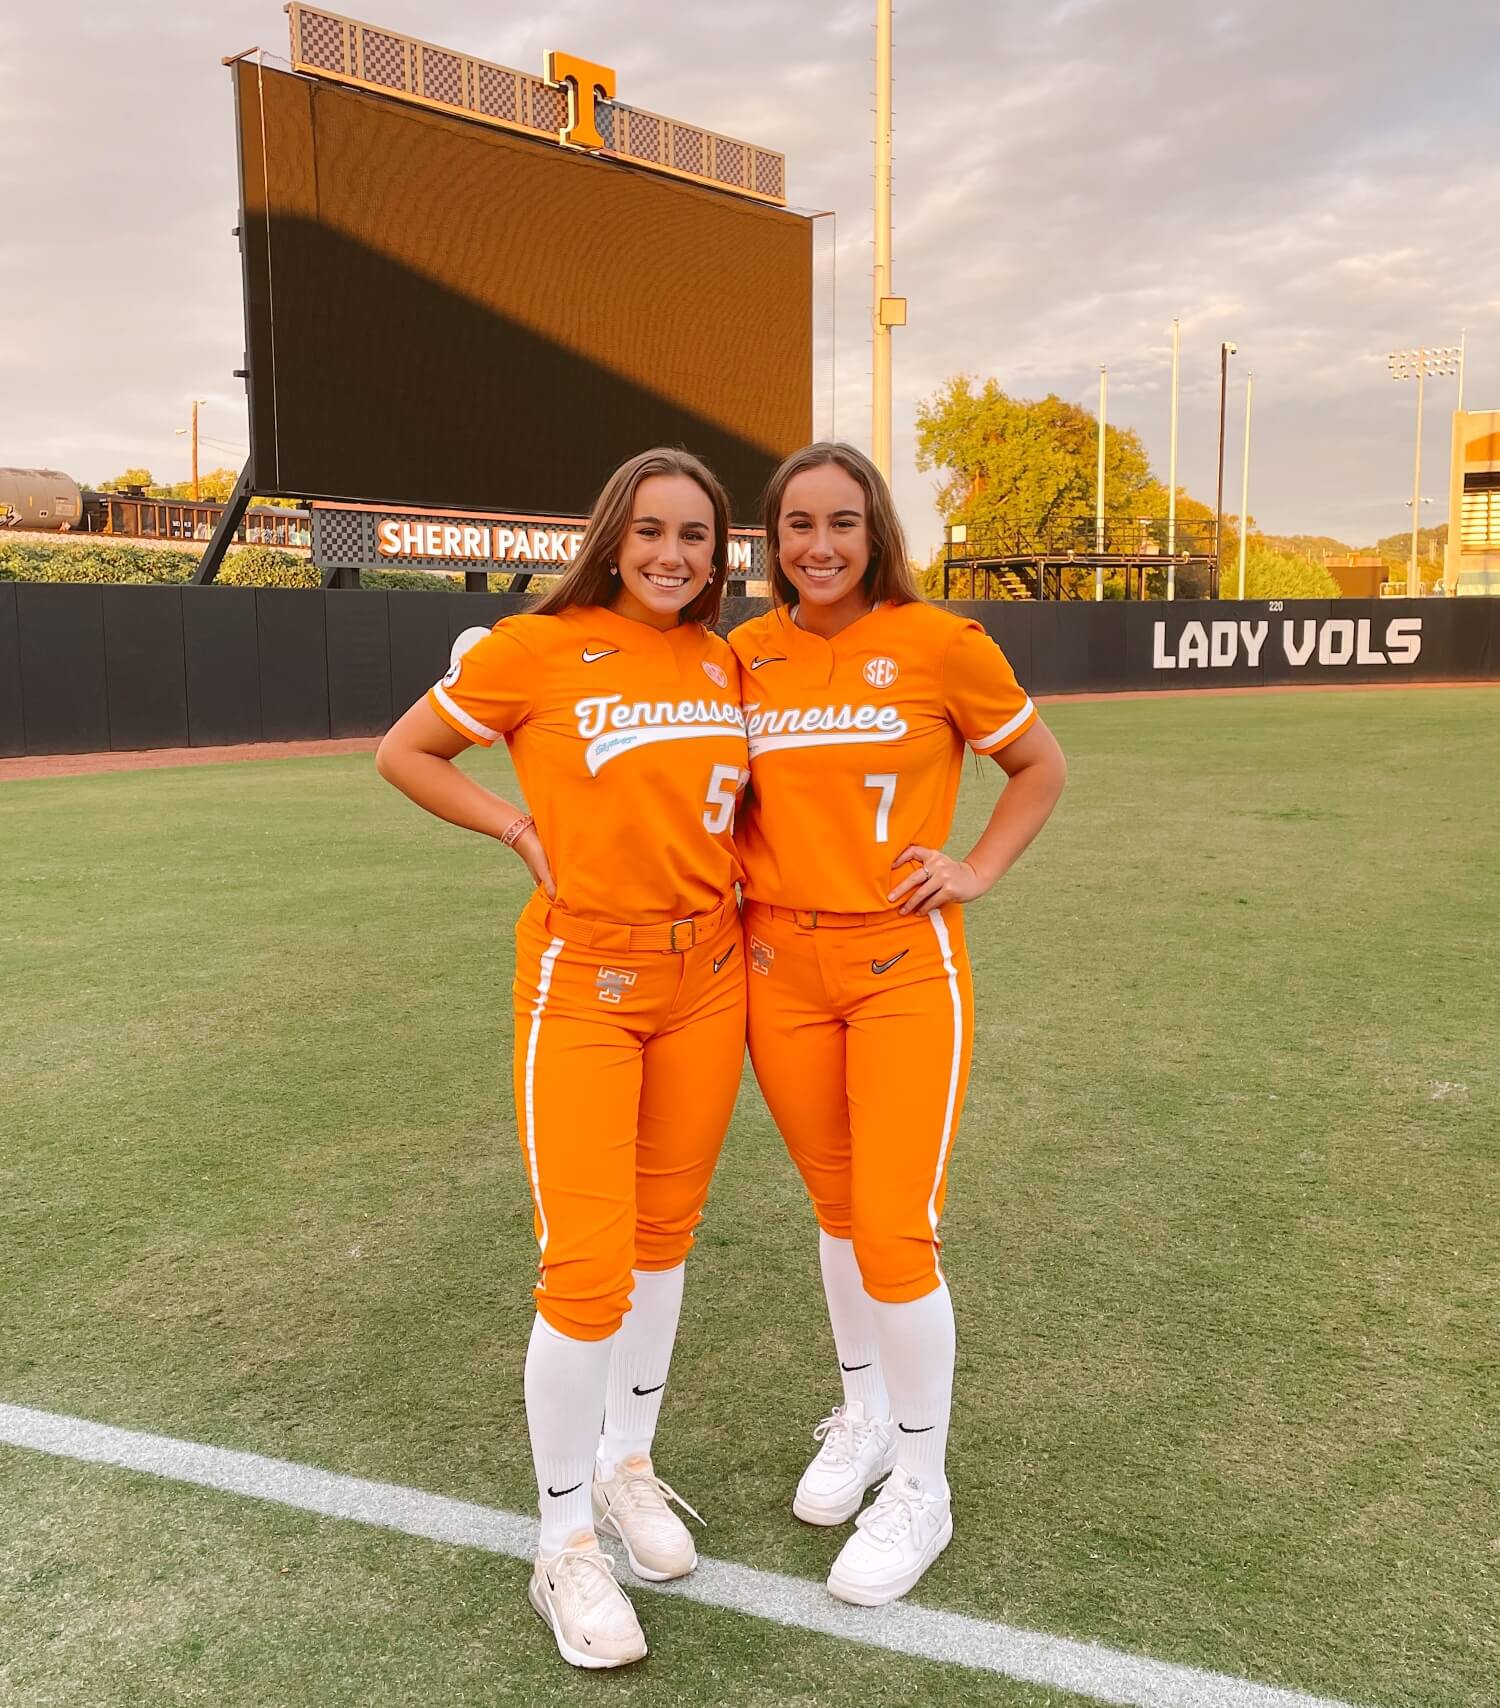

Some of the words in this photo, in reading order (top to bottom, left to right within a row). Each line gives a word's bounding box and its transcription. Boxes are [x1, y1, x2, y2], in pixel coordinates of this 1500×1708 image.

[381, 521, 490, 558] SHERRI
[1269, 601, 1283, 612] 220
[1153, 620, 1269, 669] LADY
[1283, 618, 1422, 666] VOLS
[865, 658, 896, 686] SEC
[864, 773, 898, 843] 7
